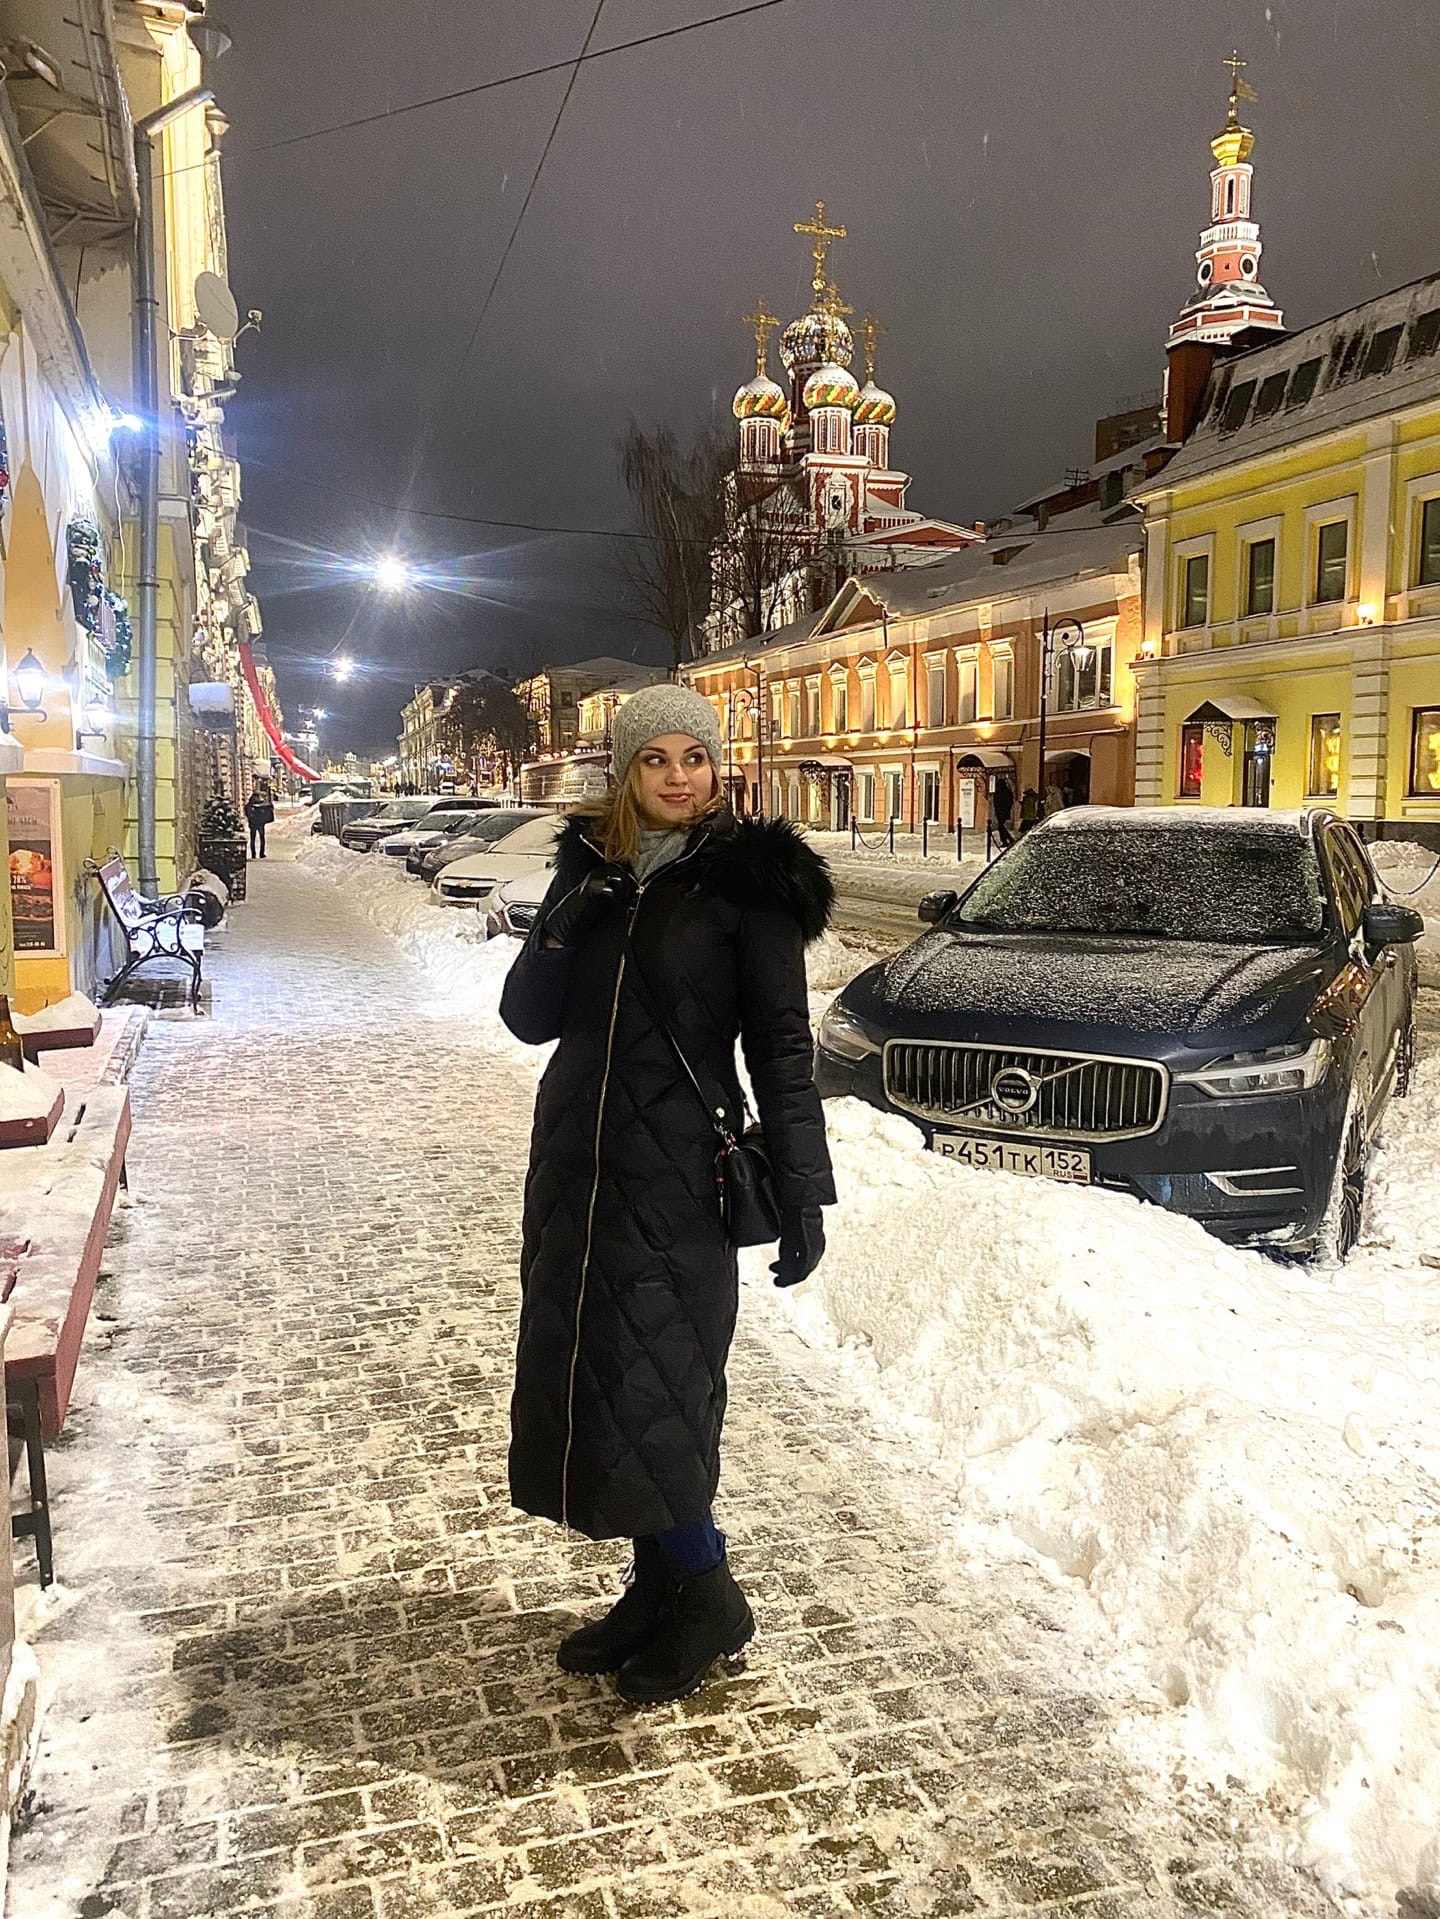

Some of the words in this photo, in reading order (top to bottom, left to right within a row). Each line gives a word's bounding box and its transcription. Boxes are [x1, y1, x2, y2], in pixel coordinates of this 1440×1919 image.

[998, 1086, 1029, 1095] VOLVO
[1045, 1151, 1083, 1171] 152
[1053, 1169, 1073, 1178] RUS
